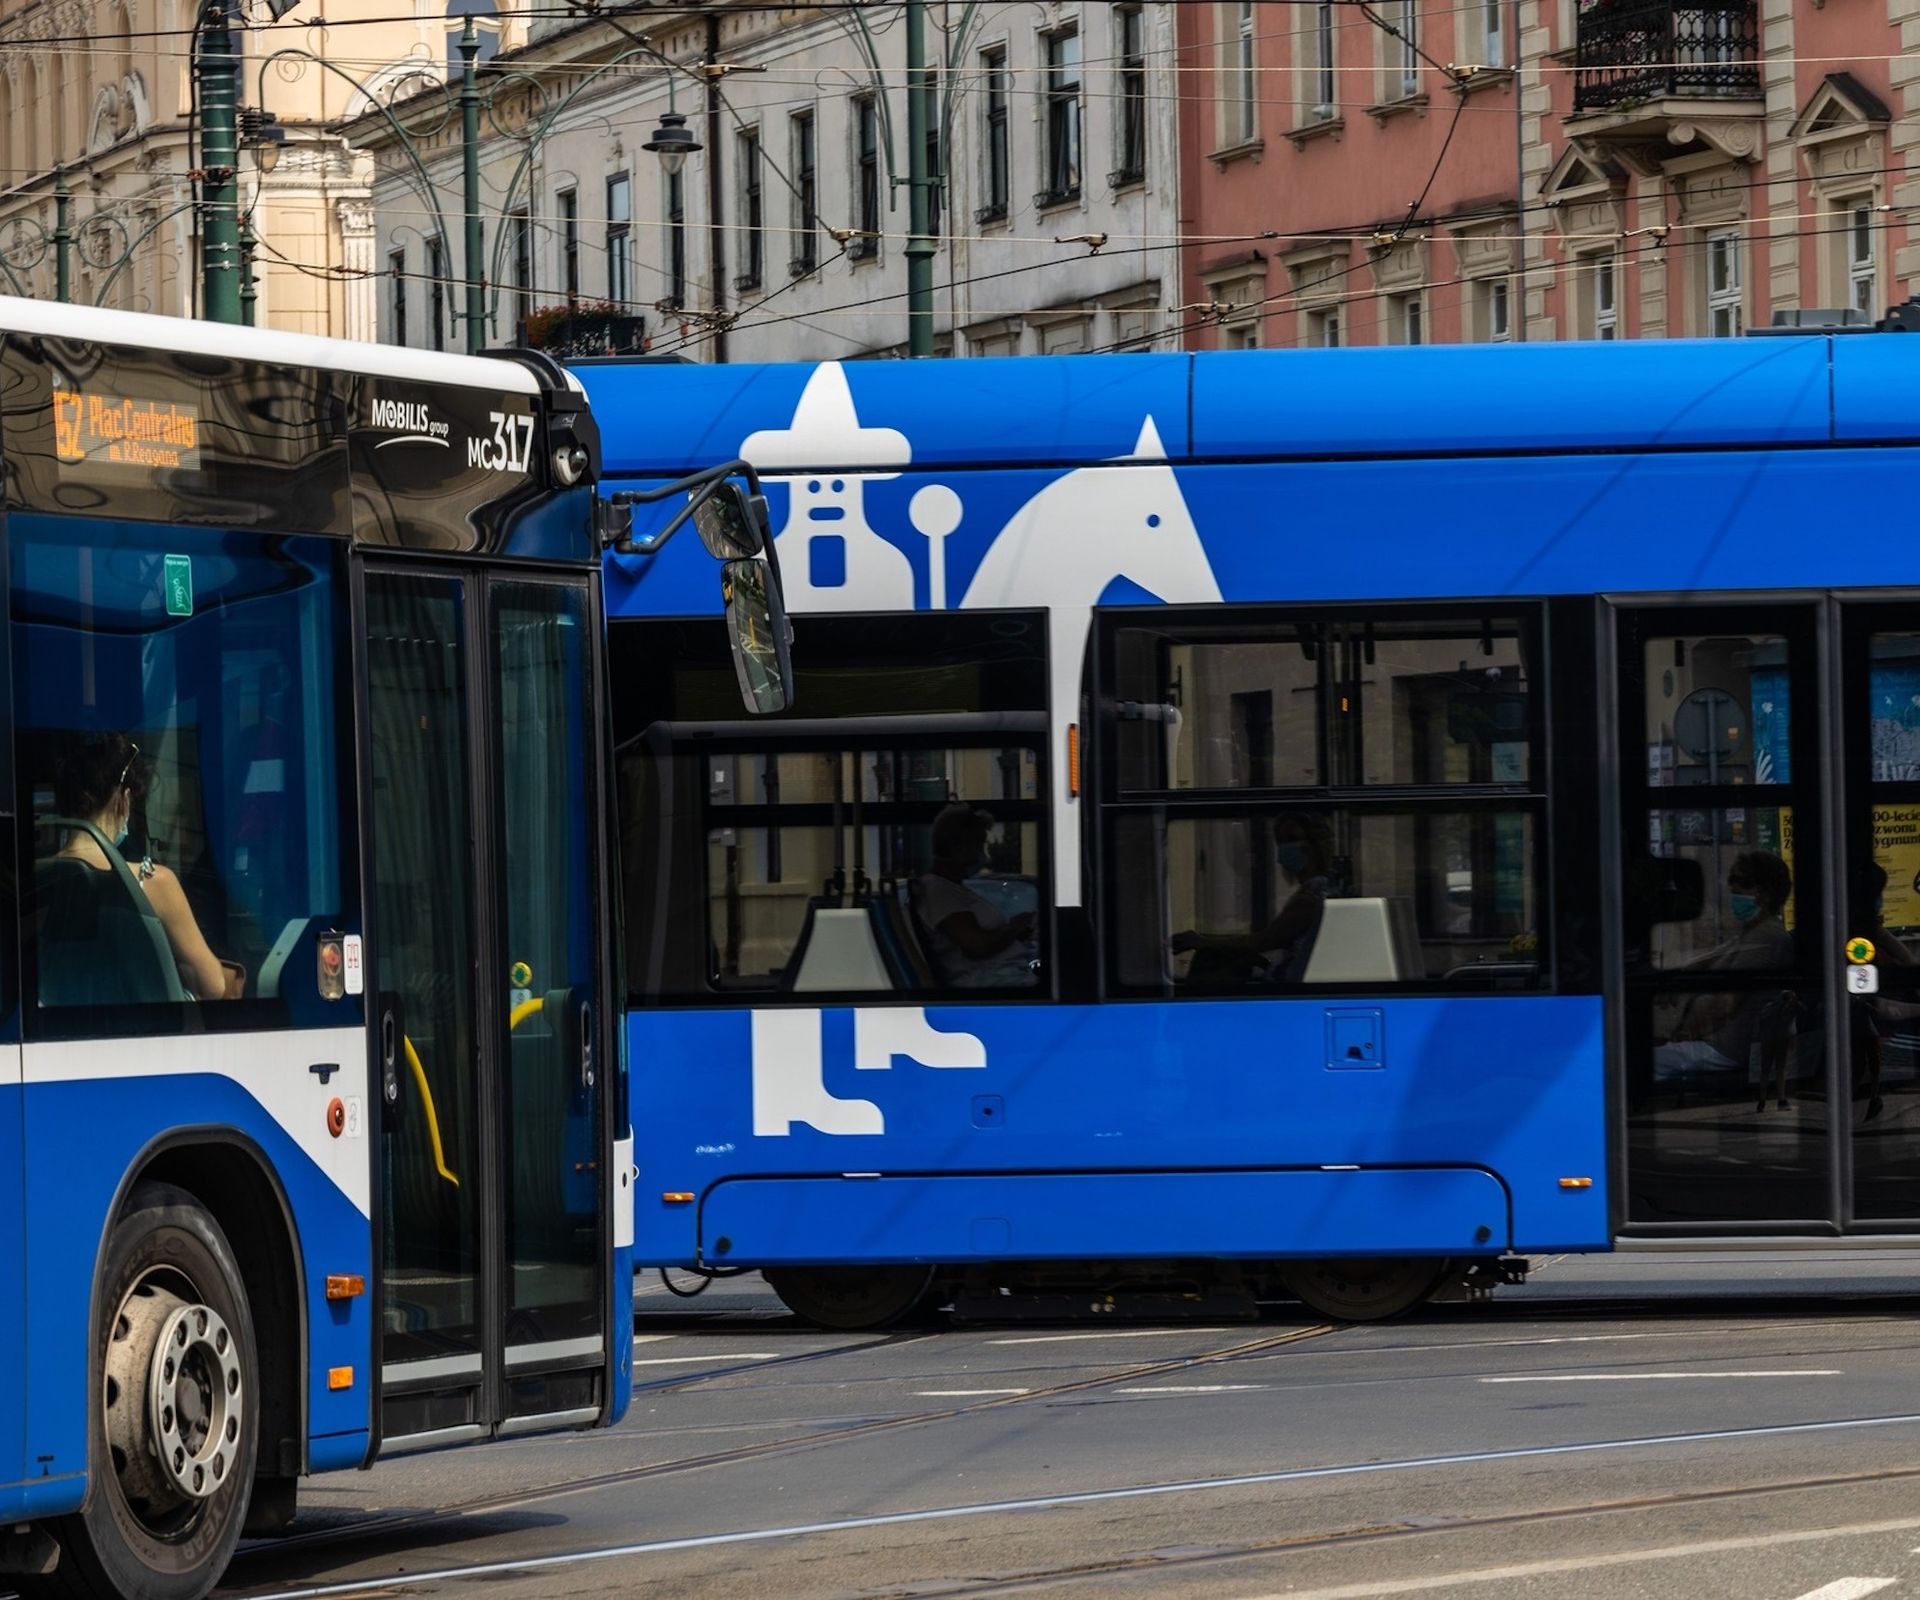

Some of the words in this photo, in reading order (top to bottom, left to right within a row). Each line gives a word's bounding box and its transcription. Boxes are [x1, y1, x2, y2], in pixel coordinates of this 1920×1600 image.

[53, 391, 85, 458] 52
[89, 395, 123, 437] Plac
[124, 398, 195, 448] Centralny
[371, 398, 429, 432] MOBILIS
[430, 421, 449, 437] group
[1872, 824, 1917, 834] zwonu
